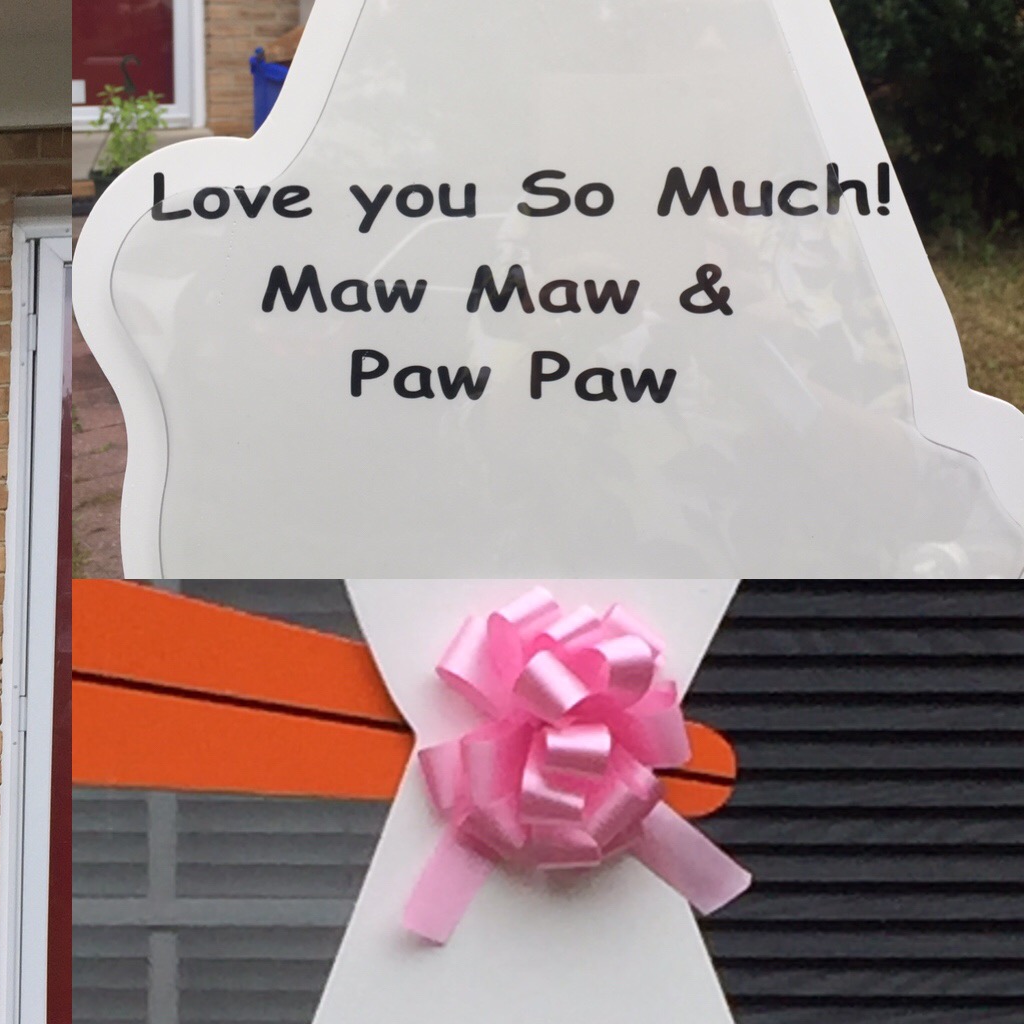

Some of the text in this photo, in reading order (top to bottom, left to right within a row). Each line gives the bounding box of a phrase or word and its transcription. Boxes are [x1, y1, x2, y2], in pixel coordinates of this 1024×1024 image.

[151, 161, 892, 234] Love you So Much!
[261, 263, 734, 316] Maw Maw &
[350, 348, 677, 404] Paw Paw
